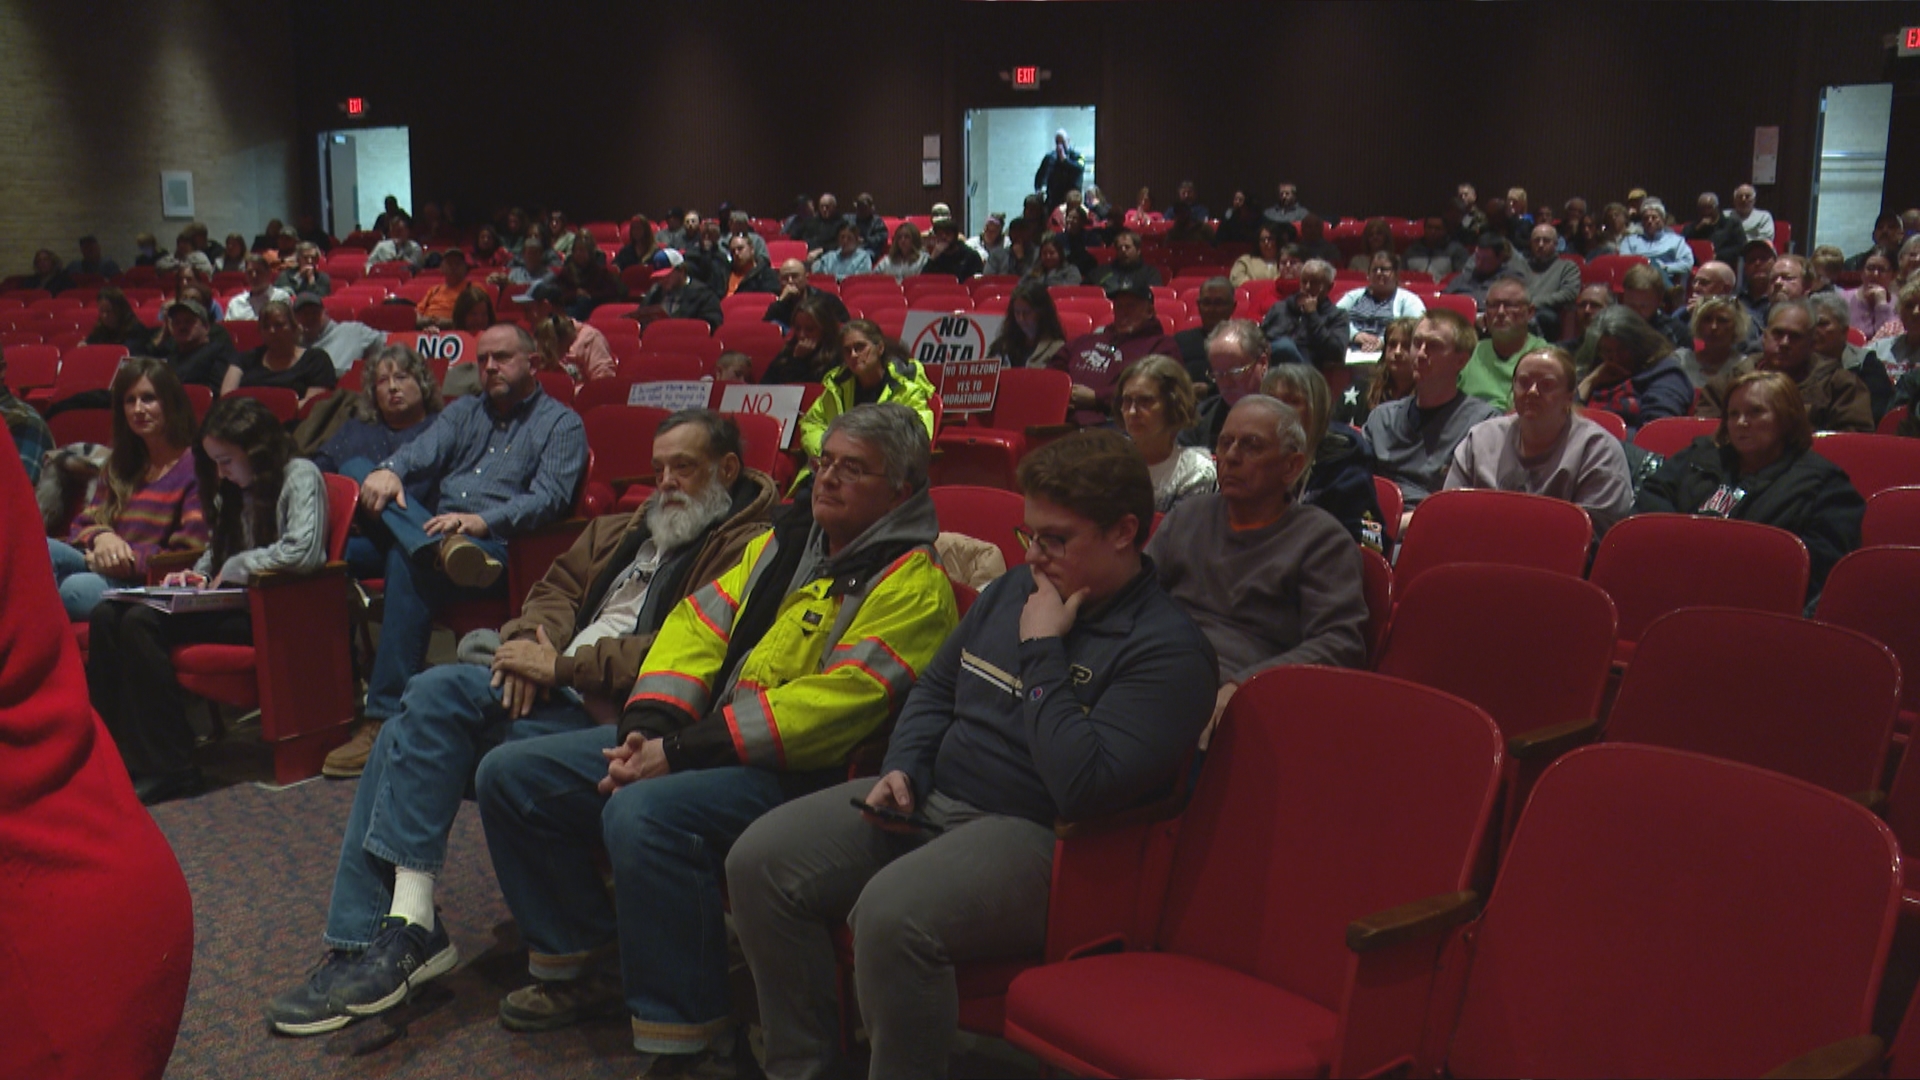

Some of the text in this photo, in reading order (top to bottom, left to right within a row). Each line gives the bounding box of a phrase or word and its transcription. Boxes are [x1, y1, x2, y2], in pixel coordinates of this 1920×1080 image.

[1017, 67, 1036, 84] EXIT
[939, 317, 969, 337] NO
[417, 335, 462, 365] NO
[919, 343, 973, 363] DATA
[945, 362, 999, 376] NO TO REZONE
[957, 380, 982, 391] YES TO
[741, 392, 773, 413] NO
[943, 392, 991, 405] MORATORIUM
